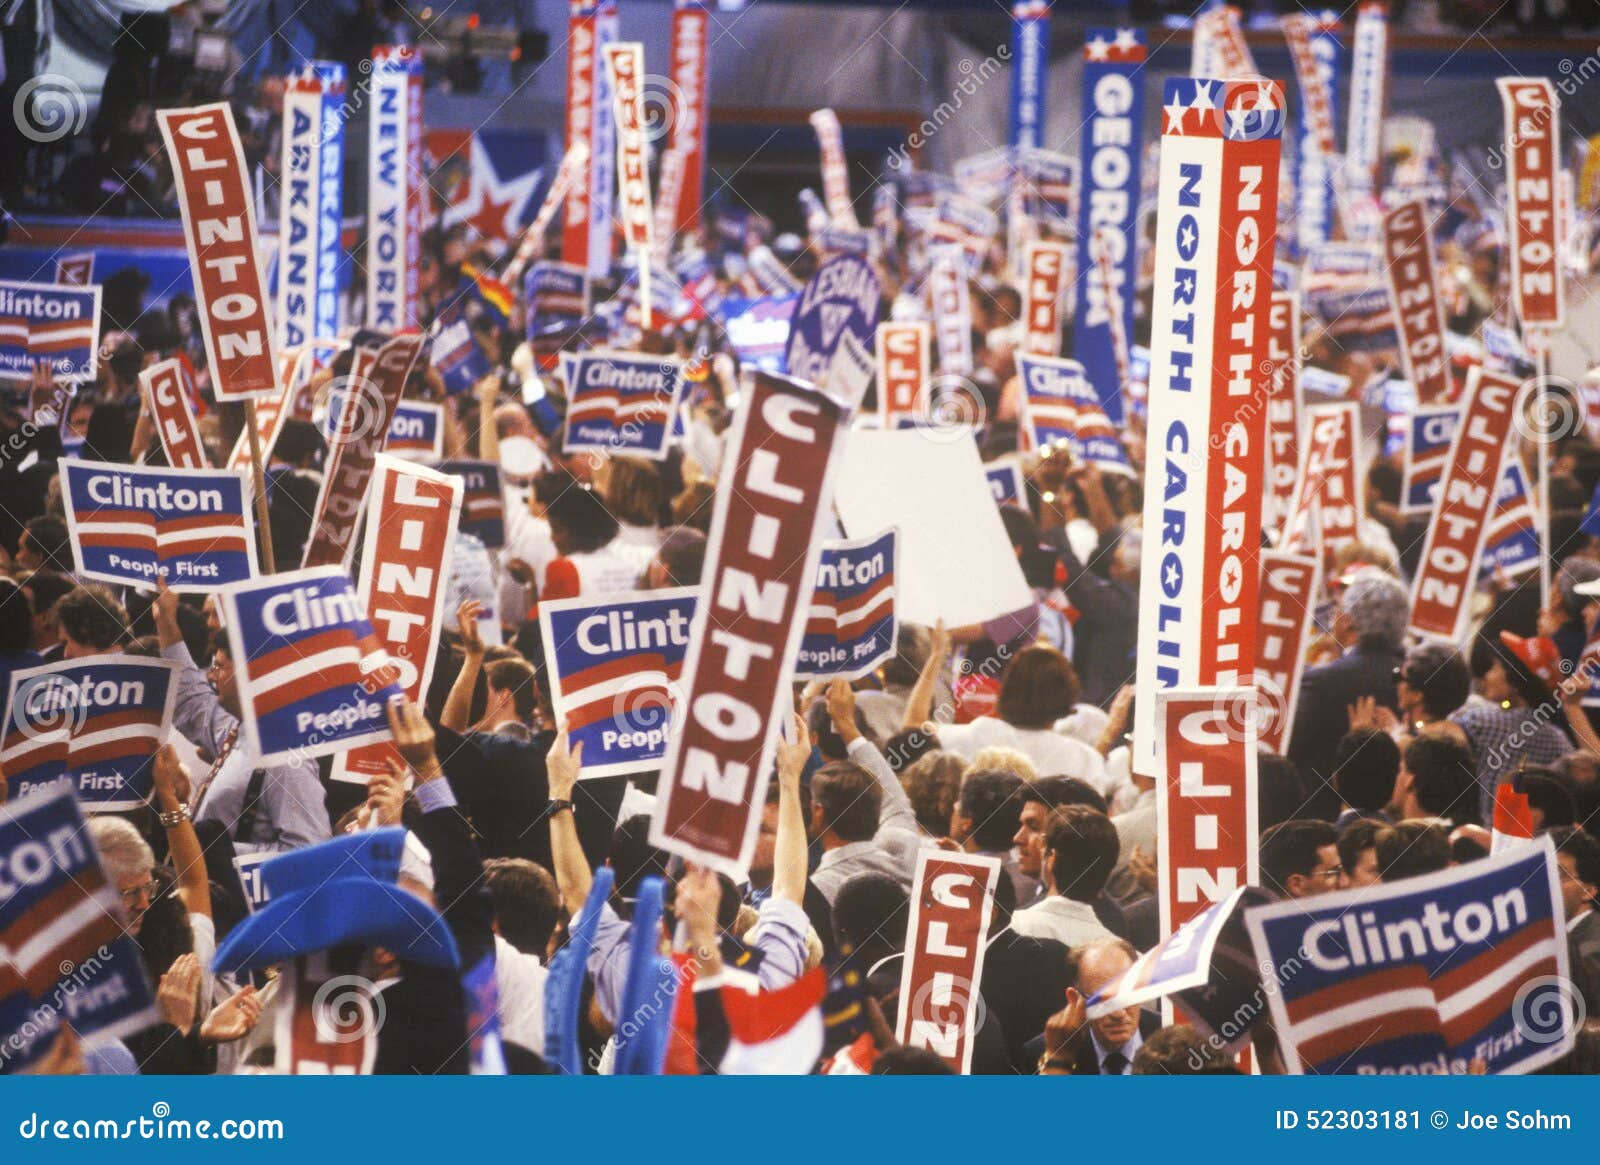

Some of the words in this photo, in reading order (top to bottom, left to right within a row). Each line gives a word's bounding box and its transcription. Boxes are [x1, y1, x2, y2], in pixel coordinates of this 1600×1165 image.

[377, 88, 397, 187] NEW
[566, 27, 594, 225] ALABMA
[1514, 87, 1553, 296] CLINTON
[179, 117, 263, 359] CLINTON
[286, 107, 311, 347] ARKANSA
[376, 207, 397, 325] YORK
[1169, 163, 1203, 392] NORTH
[1228, 166, 1263, 396] NORTH
[1389, 209, 1442, 383] CLINTON
[87, 475, 224, 512] Clinton
[109, 554, 169, 577] People
[175, 562, 219, 578] First
[816, 551, 884, 588] nton
[1421, 385, 1510, 607] CLINTON
[680, 392, 822, 807] CLINTON
[26, 674, 145, 715] Clinton
[80, 771, 124, 790] First
[297, 700, 382, 733] People
[909, 873, 975, 1059] CLIN
[1302, 886, 1528, 971] Clinton
